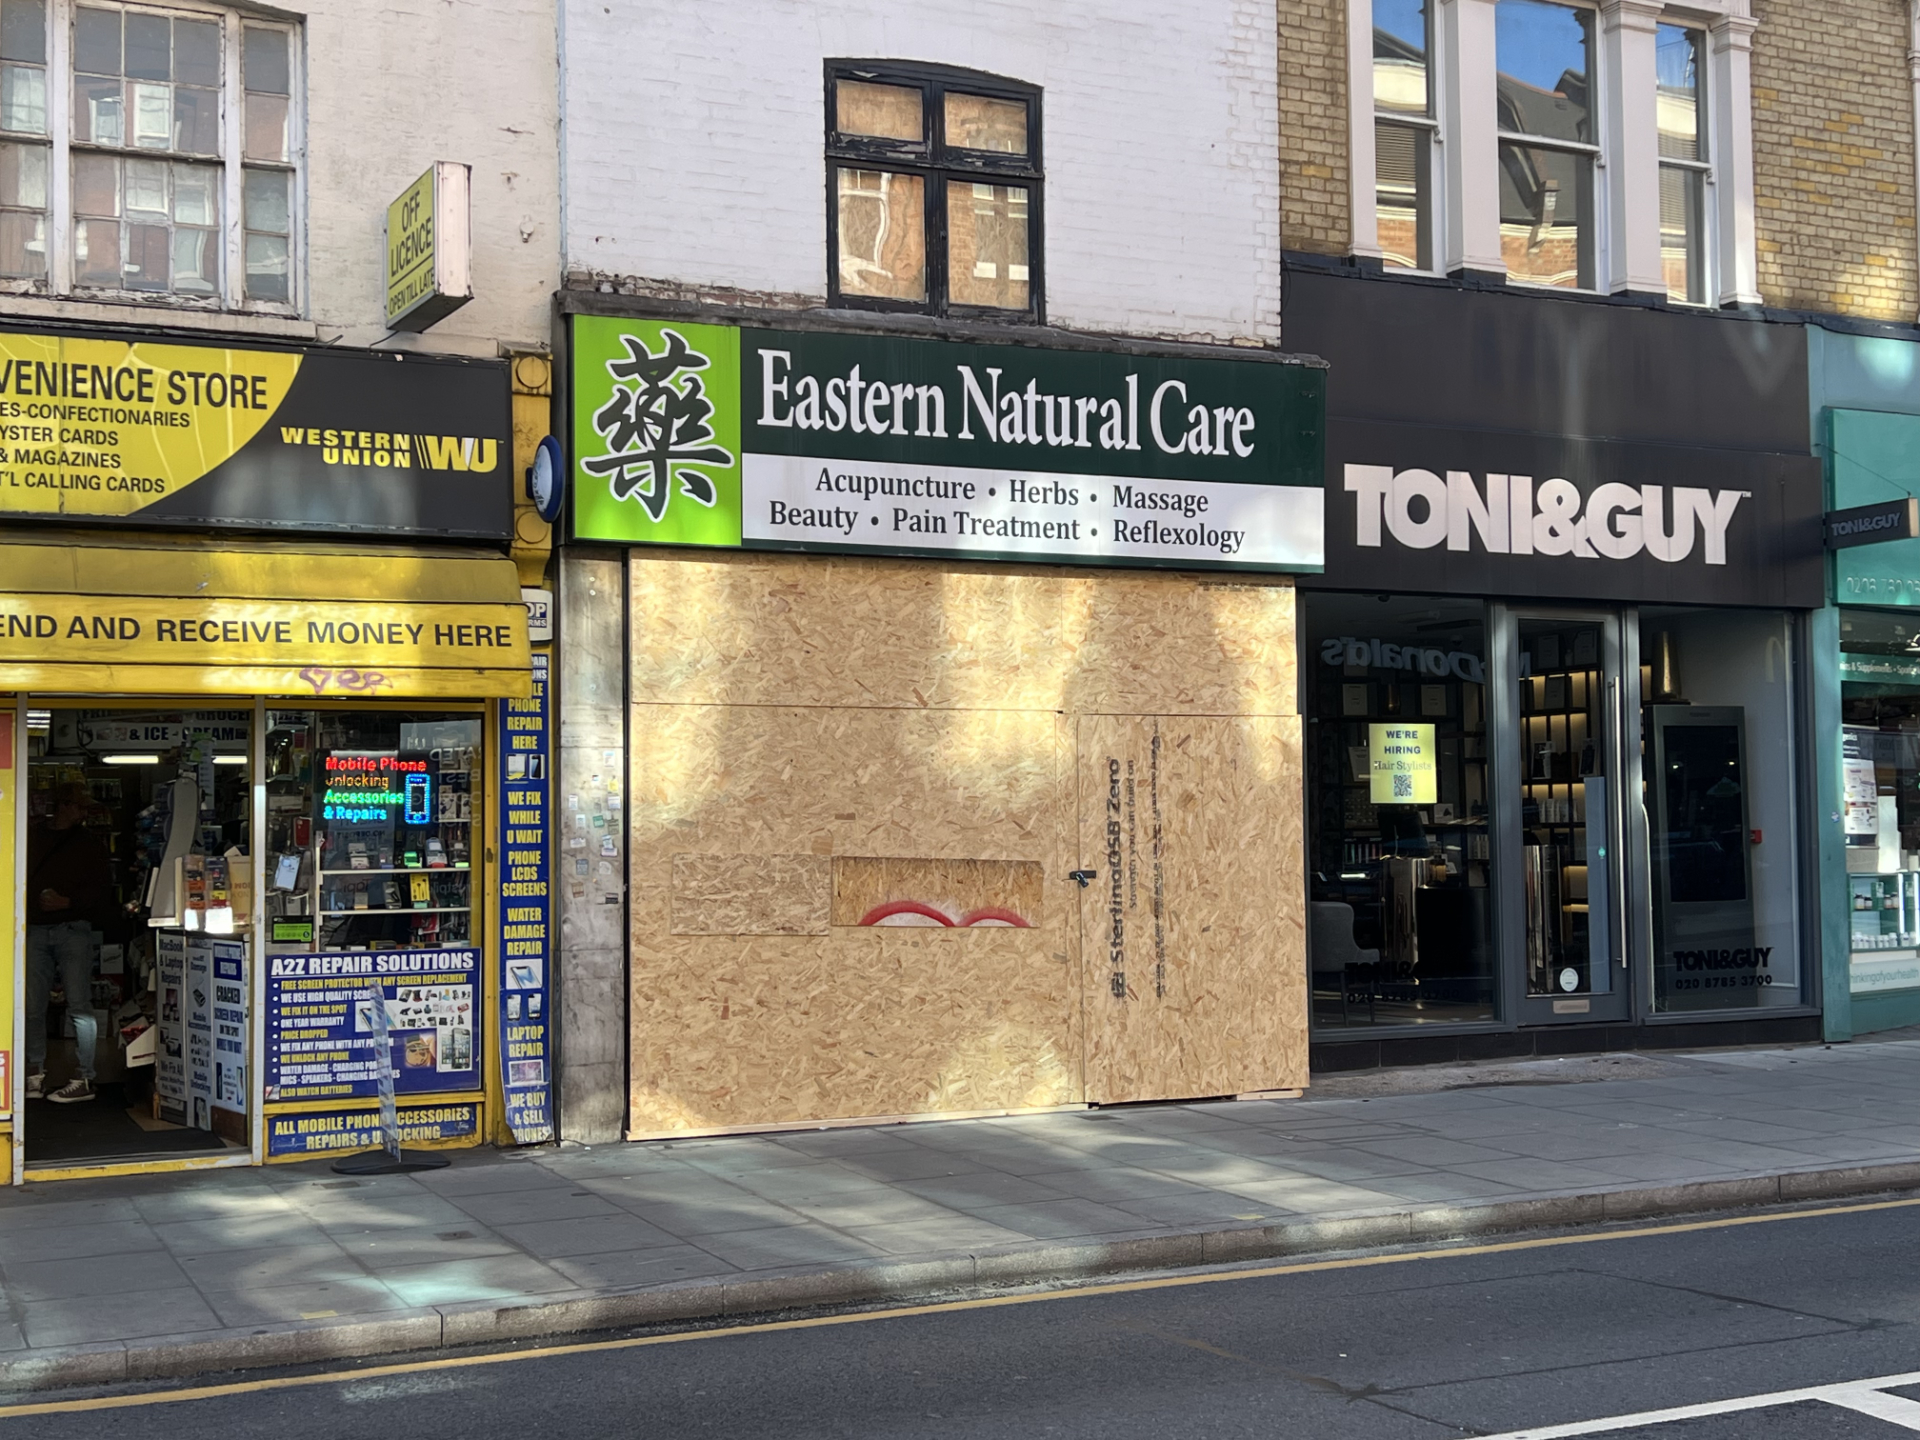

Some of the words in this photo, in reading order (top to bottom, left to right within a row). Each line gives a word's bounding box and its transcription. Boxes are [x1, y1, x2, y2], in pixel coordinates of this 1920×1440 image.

[402, 190, 420, 232] OFF
[391, 216, 431, 277] LICENCE
[389, 288, 406, 315] OPEN
[406, 279, 418, 305] TILL
[419, 266, 434, 294] LATE
[167, 370, 268, 410] STORE
[757, 348, 949, 438] Eastern
[957, 365, 1141, 450] Natural
[1151, 379, 1255, 458] Care
[60, 428, 118, 446] CARDS
[280, 427, 410, 450] WESTERN
[425, 435, 497, 473] WU
[14, 449, 121, 469] MAGAZINES
[323, 448, 410, 468] UNION
[24, 472, 101, 491] CALLING
[106, 476, 165, 493] CARDS
[816, 467, 976, 501] Acupuncture
[1009, 479, 1079, 506] Herbs
[1113, 485, 1208, 517] Massage
[1344, 463, 1745, 565] TONI&GUY
[769, 501, 858, 535] Beauty
[893, 508, 947, 534] Pain
[954, 511, 1080, 540] Treatment
[1113, 518, 1245, 553] Reflexology
[1831, 512, 1901, 536] TONI&GUY
[66, 616, 140, 640] AND
[157, 619, 292, 642] RECEIVE
[308, 621, 423, 645] MONEY
[435, 624, 512, 647] HERE
[531, 656, 547, 666] AIR
[508, 699, 541, 712] PHONE
[507, 717, 543, 730] REPAIR
[129, 729, 141, 741] &
[145, 727, 169, 741] ICE
[1386, 730, 1418, 739] WE'RE
[512, 735, 538, 749] HERE
[1384, 746, 1421, 754] HIRING
[325, 757, 376, 771] Mobile
[380, 757, 427, 772] Phone
[1396, 760, 1432, 773] Stylists
[1106, 758, 1120, 814] Zero
[323, 789, 404, 804] Accessories
[508, 791, 524, 805] WE
[526, 791, 542, 805] FIX
[323, 806, 334, 820] &
[336, 806, 387, 823] Repairs
[509, 810, 541, 824] WHILE
[506, 830, 514, 844] U
[516, 829, 543, 843] WAIT
[508, 851, 541, 865] PHONE
[512, 866, 538, 880] LCDS
[502, 882, 547, 897] SCREENS
[507, 907, 542, 922] WATER
[504, 924, 545, 939] DAMAGE
[507, 941, 542, 955] REPAIR
[271, 958, 305, 975] A2Z
[309, 956, 372, 974] REPAIR
[376, 952, 474, 971] SOLUTIONS
[1673, 947, 1774, 972] TONI&GUY
[281, 981, 296, 990] FREE
[298, 980, 323, 989] SCREEN
[324, 979, 363, 989] PROTECTOR
[383, 977, 396, 986] ANY
[397, 976, 421, 986] SCREEN
[422, 973, 467, 985] REPLACEMENT
[1675, 978, 1699, 990] 020
[1705, 976, 1736, 988] 8785
[1741, 974, 1772, 986] 3700
[281, 993, 291, 1003] WE
[293, 992, 304, 1003] USE
[306, 991, 324, 1002] HIGH
[325, 990, 352, 1001] QUALITY
[319, 1005, 332, 1014] THE
[332, 1004, 347, 1014] SPOT
[280, 1018, 292, 1028] ONE
[293, 1017, 308, 1027] YEAR
[309, 1016, 344, 1026] WARRANTY
[280, 1031, 298, 1040] PRICE
[300, 1029, 328, 1039] DROPPED
[507, 1025, 544, 1041] LAPTOP
[508, 1042, 544, 1057] REPAIR
[280, 1066, 301, 1075] WATER
[303, 1064, 329, 1074] DAMAGE
[332, 1063, 363, 1072] CHARGING
[280, 1076, 298, 1085] MICS
[301, 1074, 332, 1084] SPEAKERS
[337, 1071, 367, 1082] CHANGING
[280, 1088, 295, 1097] ALSO
[321, 1085, 352, 1096] BATTERIES
[509, 1093, 526, 1107] WE
[526, 1091, 546, 1106] BUY
[275, 1121, 295, 1135] ALL
[298, 1117, 343, 1133] MOBILE
[347, 1115, 380, 1130] PHON
[397, 1107, 470, 1125] CCESSORIES
[523, 1110, 544, 1124] SELL
[306, 1132, 358, 1149] REPAIRS
[361, 1133, 369, 1145] &
